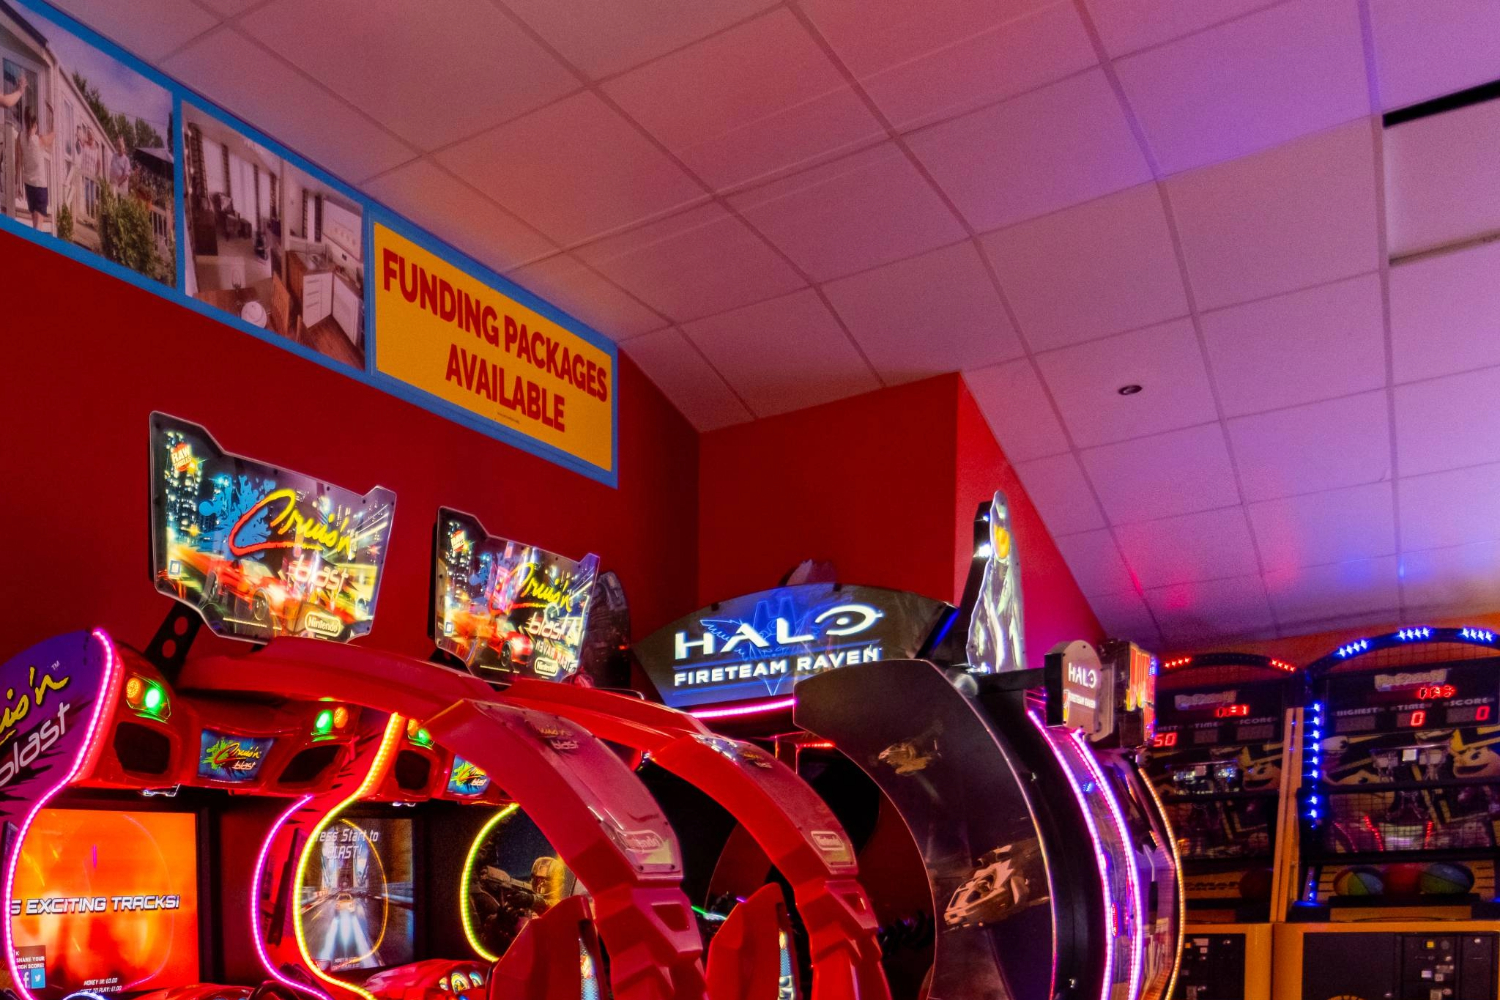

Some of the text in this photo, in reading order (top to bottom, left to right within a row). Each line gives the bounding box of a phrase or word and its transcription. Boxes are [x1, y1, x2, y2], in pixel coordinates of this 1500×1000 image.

[383, 247, 608, 403] FUNDING PACKAGES
[445, 343, 565, 432] AVAILABLE
[171, 446, 191, 462] RAW
[308, 614, 340, 632] Nintendo
[675, 604, 884, 659] HALO
[674, 648, 880, 687] FIRETEAM RAVEN
[312, 828, 379, 842] ress Start to
[26, 897, 107, 915] EXCITING
[111, 894, 181, 912] TRACKS!
